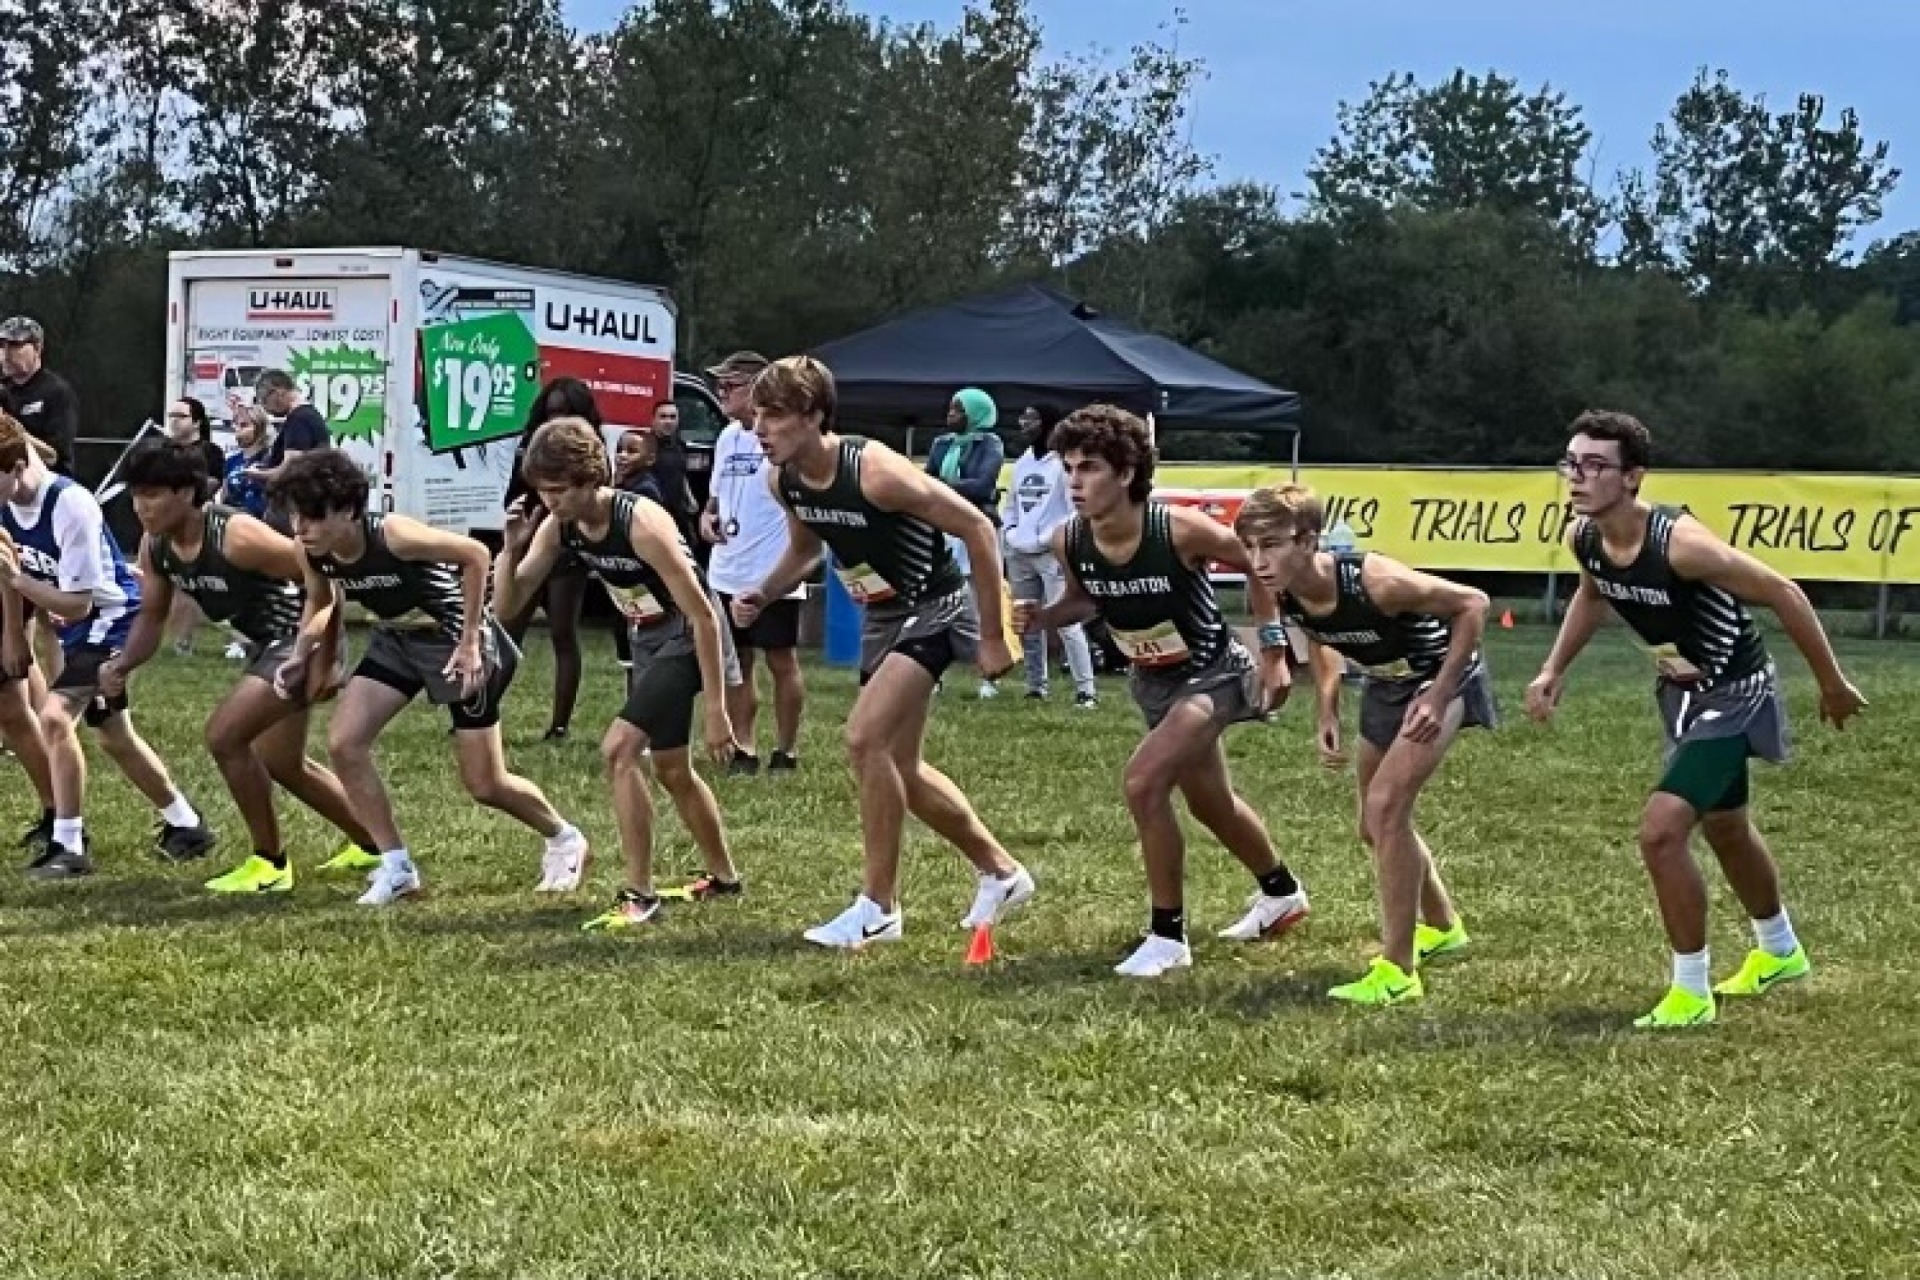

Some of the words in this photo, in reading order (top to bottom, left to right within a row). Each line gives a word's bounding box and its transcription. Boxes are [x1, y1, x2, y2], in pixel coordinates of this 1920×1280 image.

[1410, 498, 1526, 543] TRIALS
[1728, 504, 1856, 551] TRIALS
[1868, 507, 1920, 555] OF
